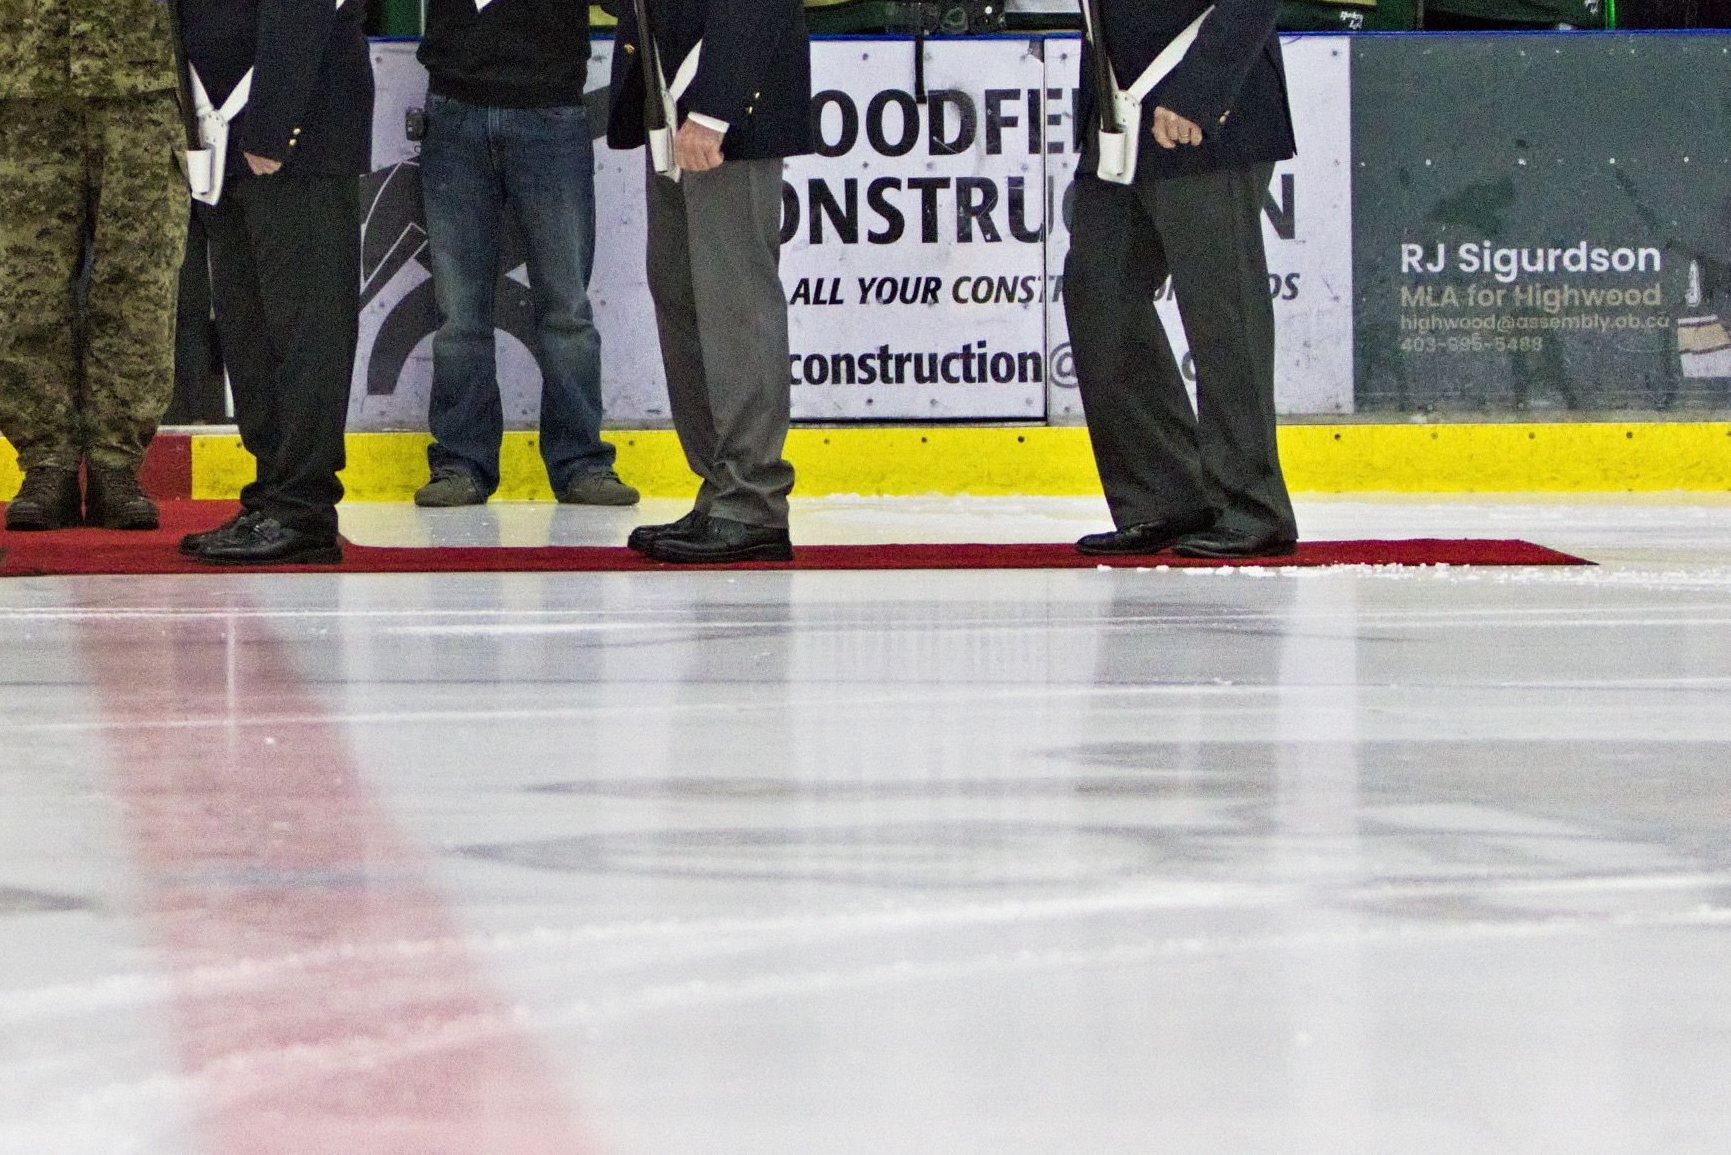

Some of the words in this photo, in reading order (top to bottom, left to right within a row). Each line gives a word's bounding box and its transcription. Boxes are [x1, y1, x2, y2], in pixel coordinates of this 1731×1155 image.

[1401, 243, 1446, 273] RJ
[1458, 240, 1661, 283] Sigurdson
[789, 277, 844, 305] ALL
[858, 276, 942, 305] YOUR
[1400, 286, 1458, 307] MLA
[1469, 286, 1507, 307] for
[1516, 283, 1662, 314] Highwood
